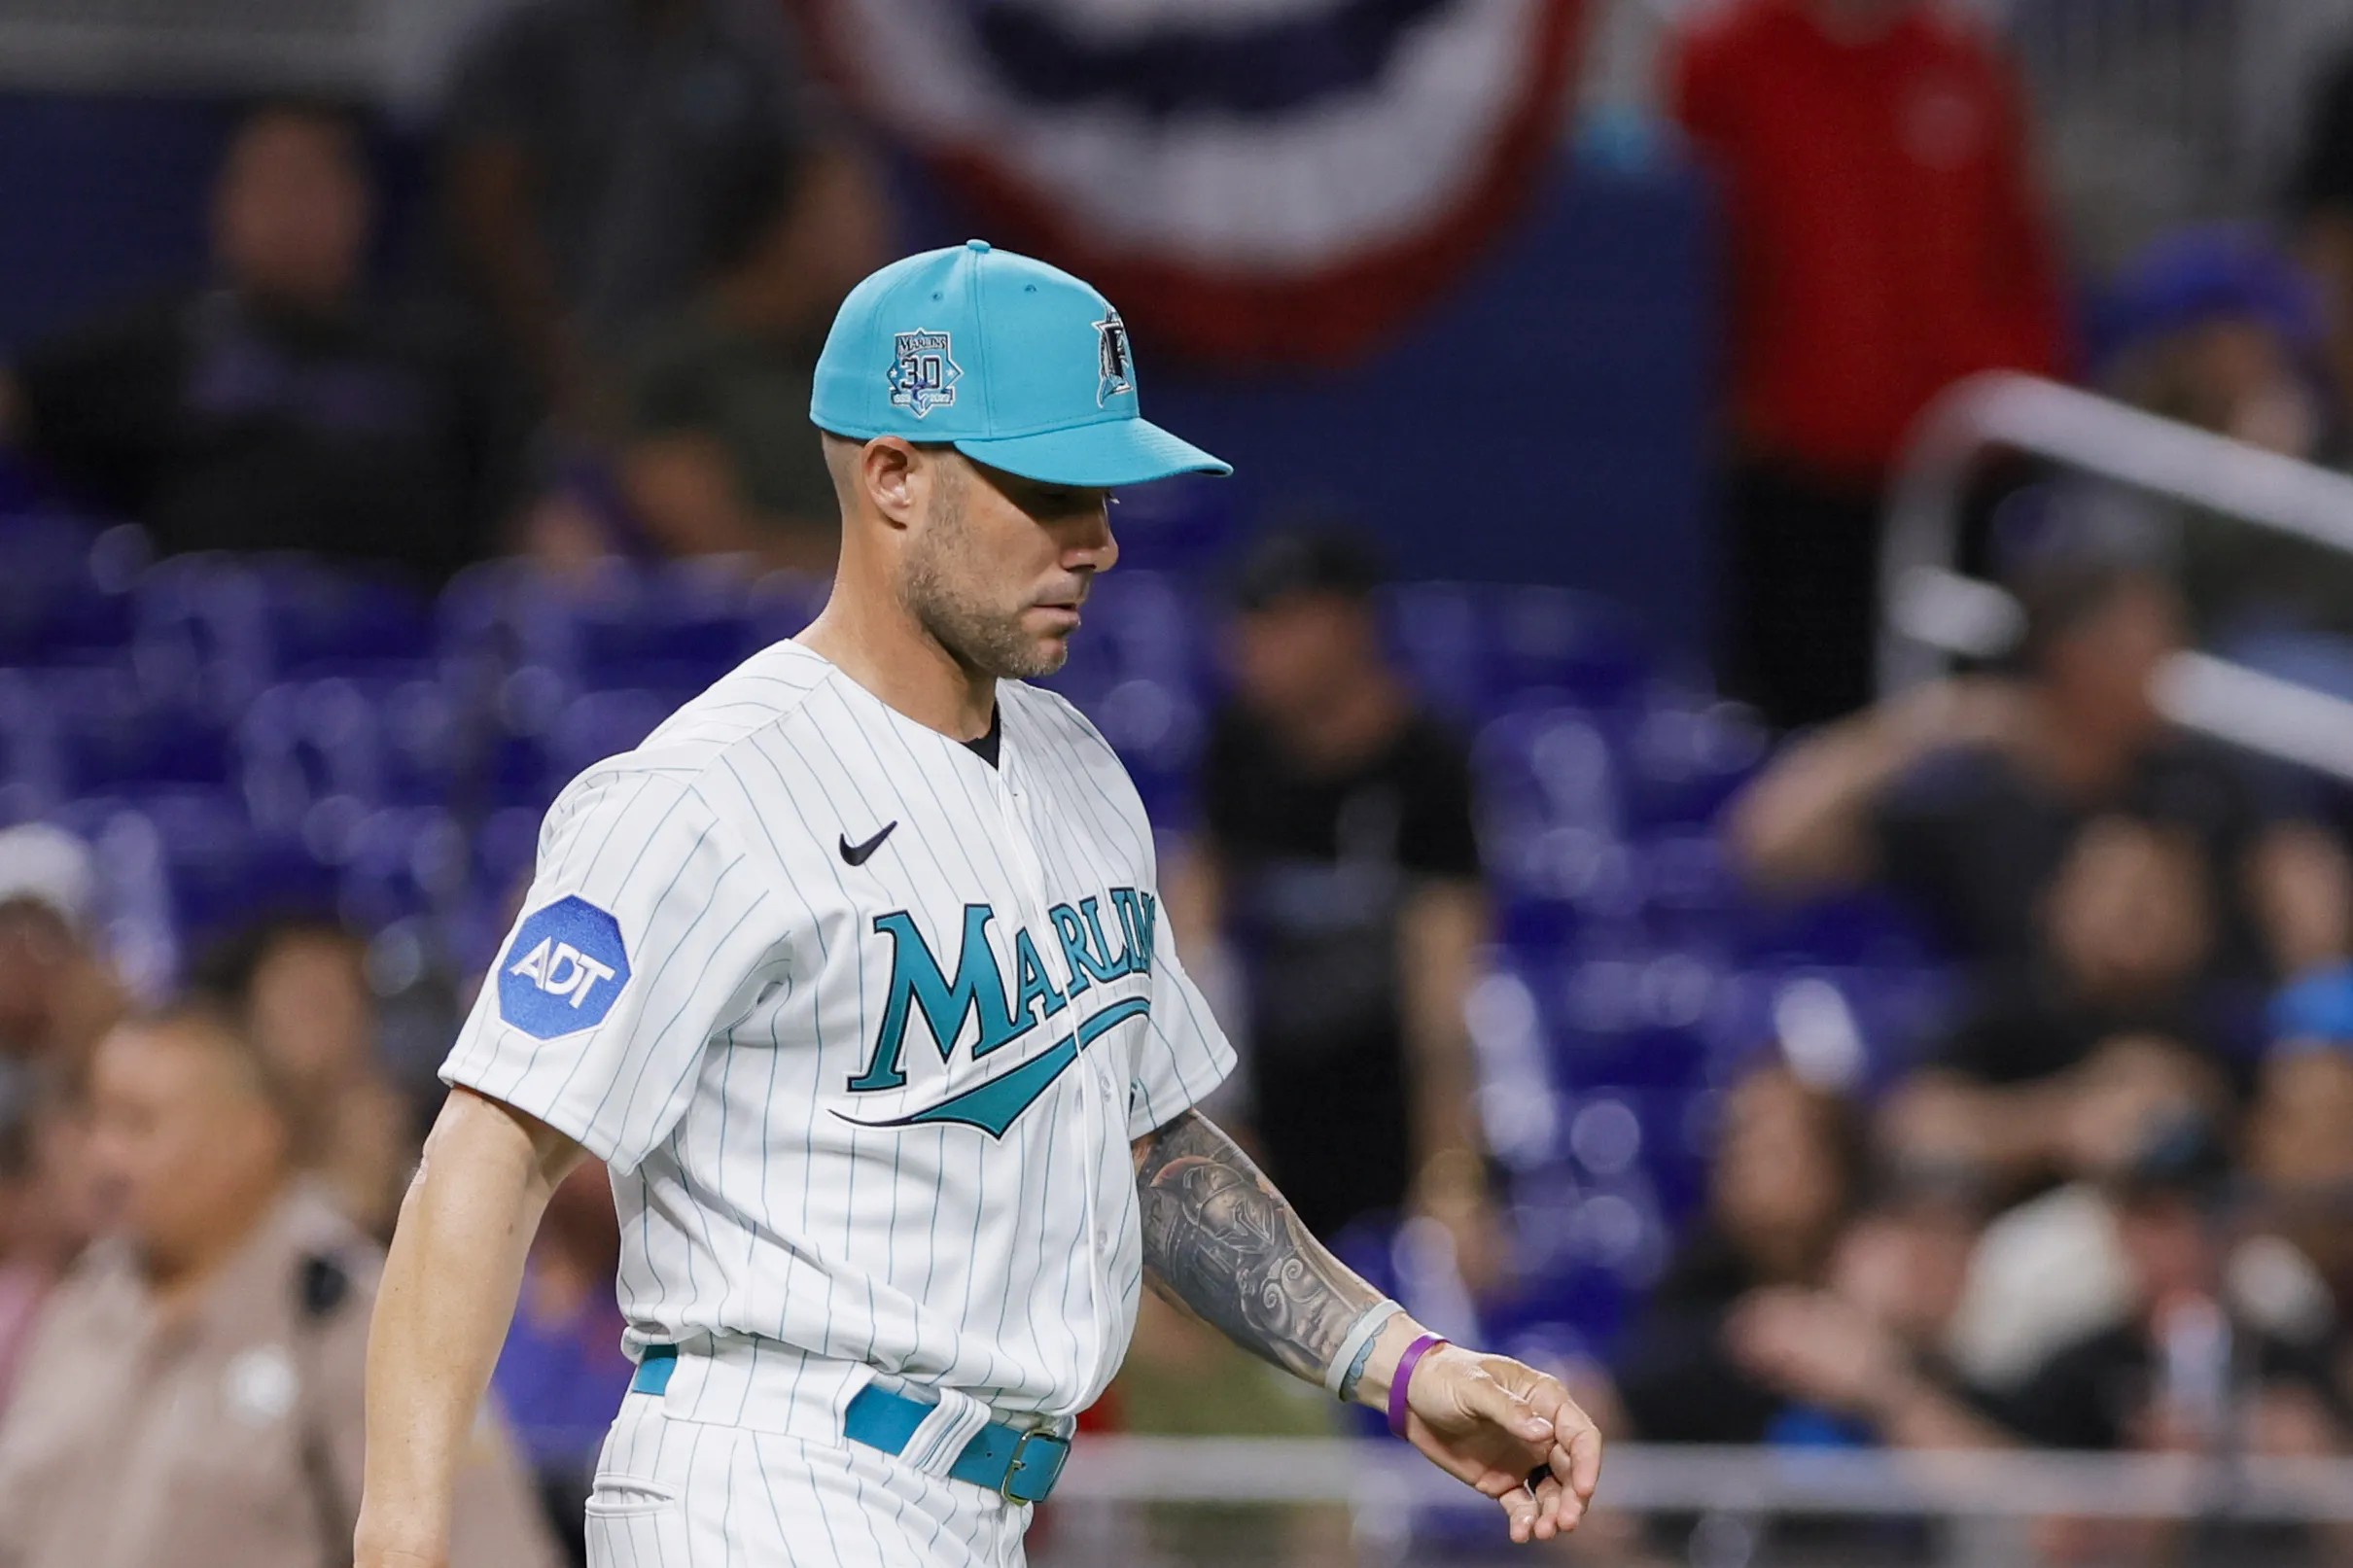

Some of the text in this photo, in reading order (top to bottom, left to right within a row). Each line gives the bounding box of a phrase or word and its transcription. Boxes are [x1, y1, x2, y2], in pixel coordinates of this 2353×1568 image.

[900, 356, 940, 389] 30
[509, 935, 615, 1009] ADT
[847, 887, 1155, 1093] MARLIN
